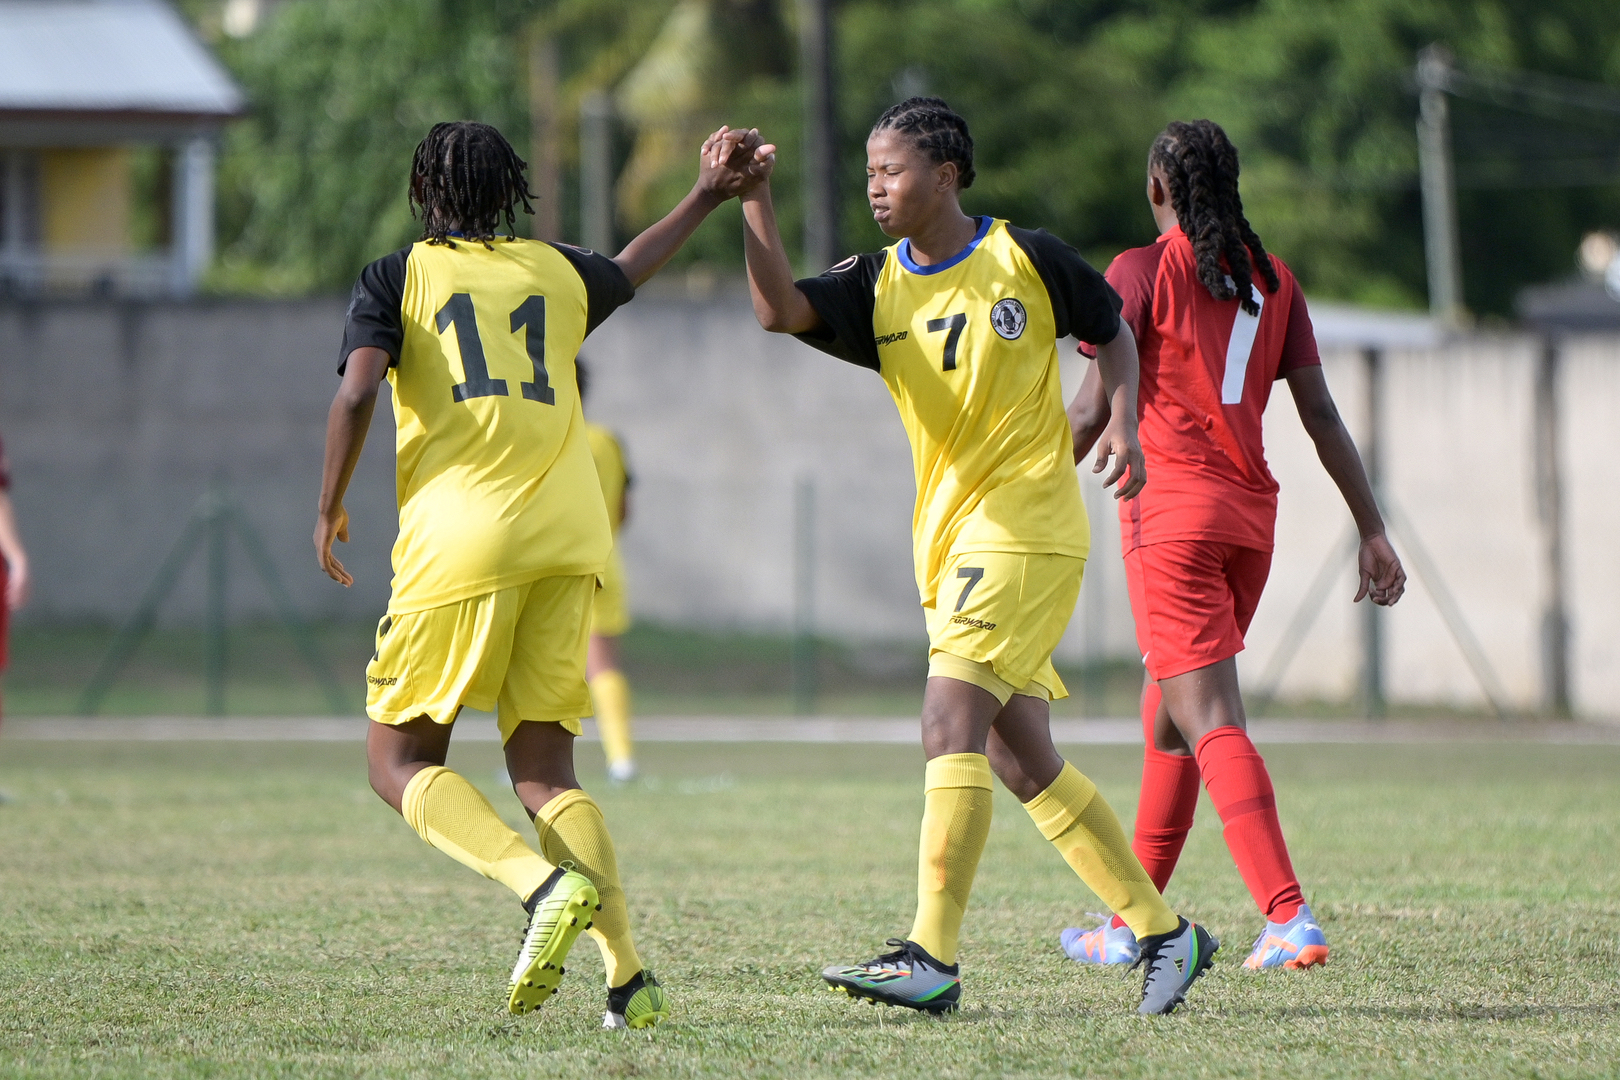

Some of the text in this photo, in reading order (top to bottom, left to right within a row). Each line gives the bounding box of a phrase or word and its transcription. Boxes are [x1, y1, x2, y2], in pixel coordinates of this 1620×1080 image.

[435, 292, 555, 406] 11
[927, 312, 967, 371] 7
[953, 567, 985, 613] 7
[949, 615, 997, 631] FORWARD
